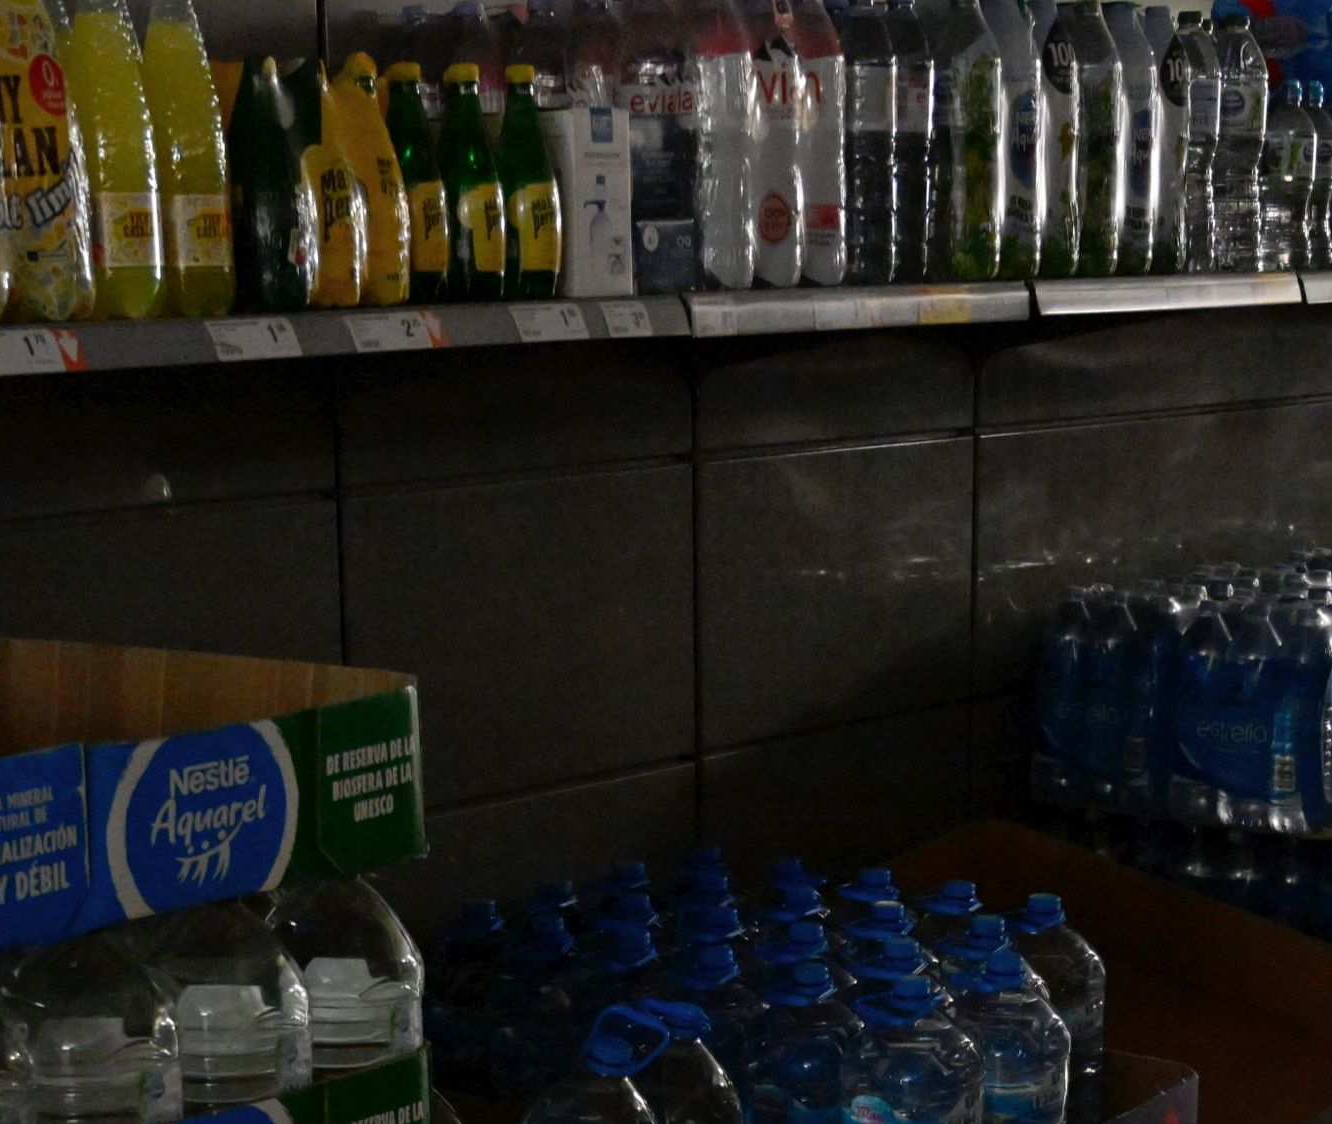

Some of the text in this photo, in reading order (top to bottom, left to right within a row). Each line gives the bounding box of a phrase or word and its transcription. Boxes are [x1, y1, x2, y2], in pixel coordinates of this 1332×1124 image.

[6, 785, 55, 811] MINERAL
[353, 797, 395, 823] UNESCO
[33, 807, 49, 825] DE
[151, 784, 267, 848] Aquarel
[14, 859, 71, 902] DÉBIL
